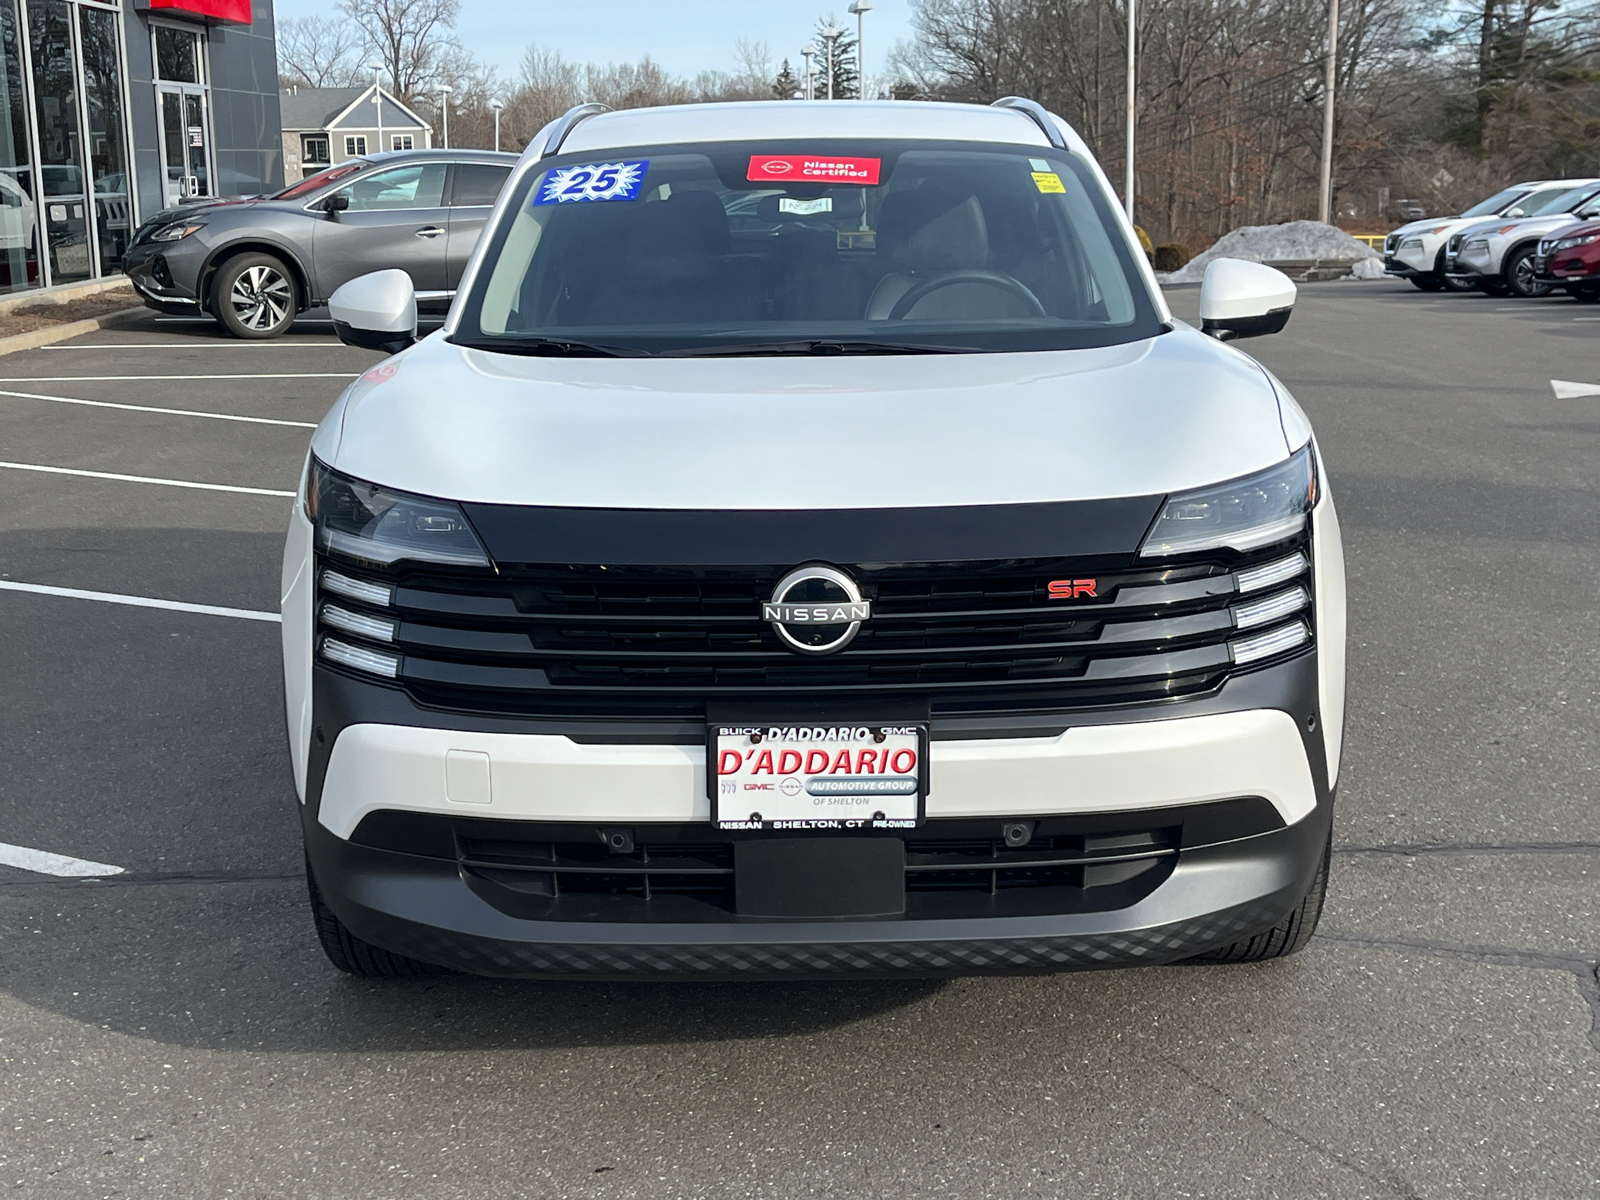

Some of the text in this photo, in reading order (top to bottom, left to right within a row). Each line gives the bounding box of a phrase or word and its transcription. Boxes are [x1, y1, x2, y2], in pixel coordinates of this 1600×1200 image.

[804, 161, 855, 169] Nissan
[803, 168, 867, 177] Certified
[560, 168, 619, 194] 25
[1048, 578, 1097, 599] SR
[764, 604, 868, 622] NISSAN
[719, 727, 917, 742] BUICK D'ADDARIO GMC
[718, 749, 916, 775] D'ADDARIO
[811, 781, 913, 790] AUTOMOTIVE GROUP
[813, 797, 870, 805] OF SHELTON
[720, 821, 762, 829] NISSAN
[773, 820, 865, 829] SHELTON, CT
[872, 820, 916, 828] PRE-OWNED
